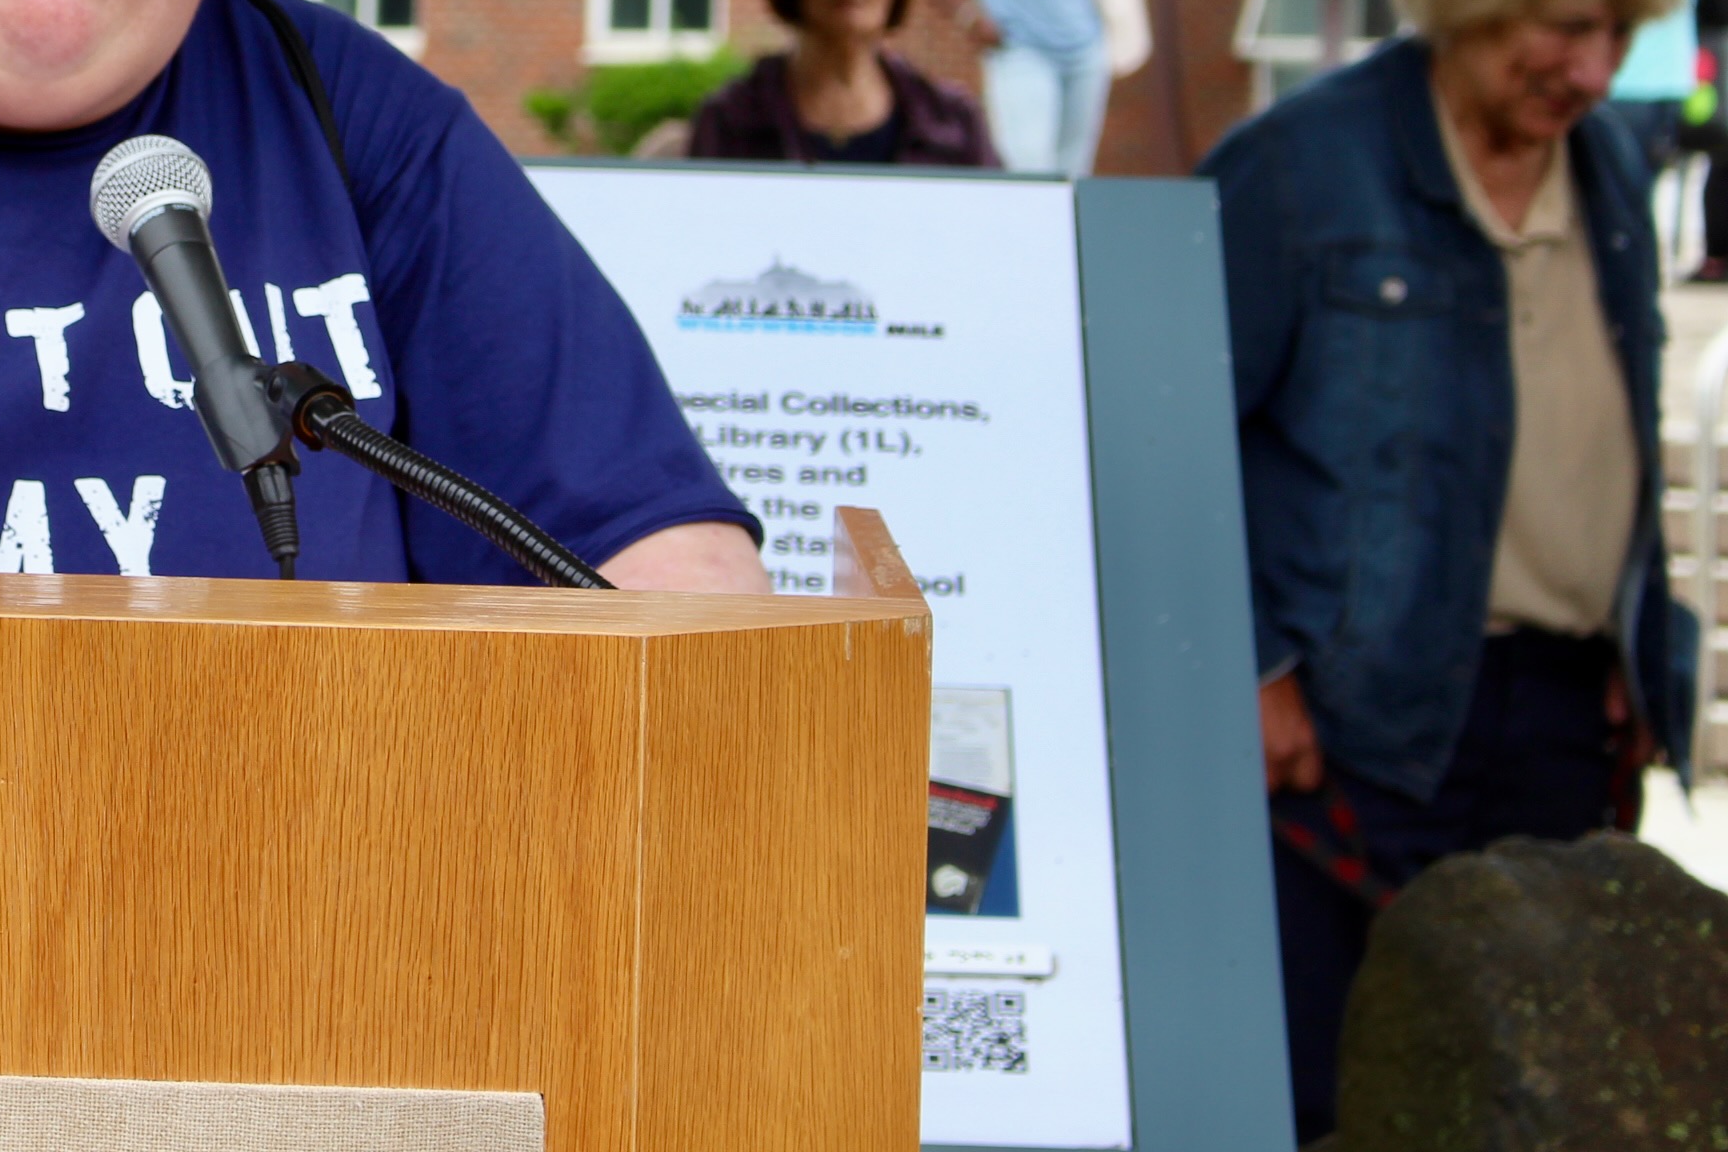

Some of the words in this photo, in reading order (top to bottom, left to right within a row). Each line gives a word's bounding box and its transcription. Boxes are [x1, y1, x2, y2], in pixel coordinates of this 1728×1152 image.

[779, 390, 992, 424] Collections,
[694, 424, 826, 456] Library
[839, 429, 923, 458] (1L),
[797, 462, 870, 487] and
[761, 497, 822, 521] the
[773, 534, 833, 556] sta
